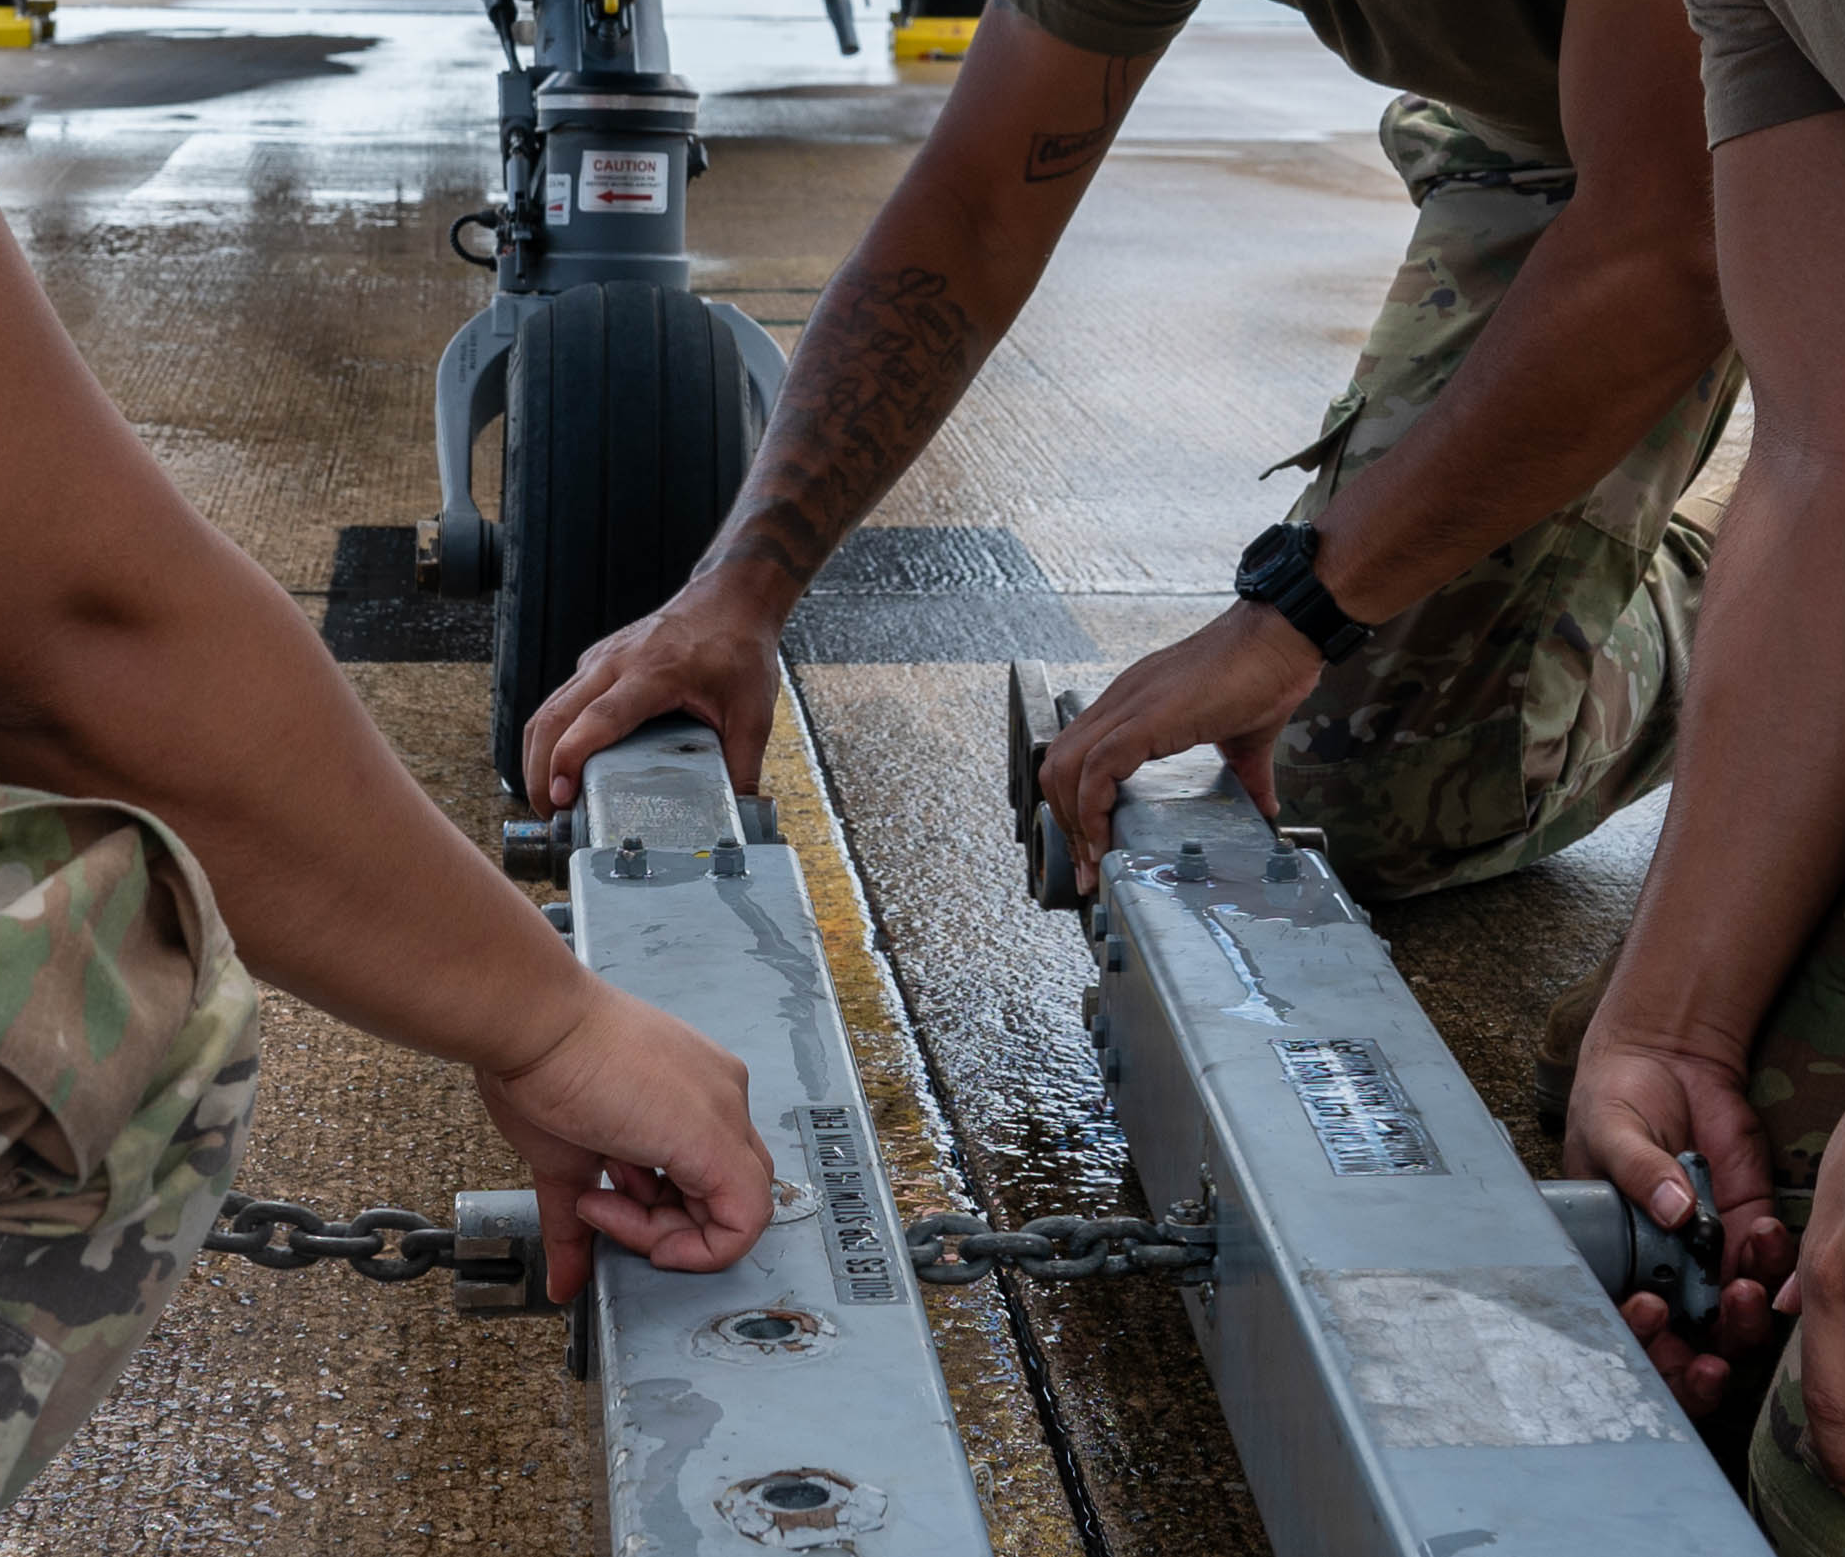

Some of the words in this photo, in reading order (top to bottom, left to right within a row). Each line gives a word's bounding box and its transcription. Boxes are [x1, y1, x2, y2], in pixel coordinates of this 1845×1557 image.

[593, 159, 657, 173] CAUTION
[809, 1108, 849, 1129] END
[815, 1133, 859, 1166] CHAIN
[823, 1171, 873, 1224] STOWING
[838, 1228, 883, 1252] FOR
[845, 1258, 895, 1300] HOLES
